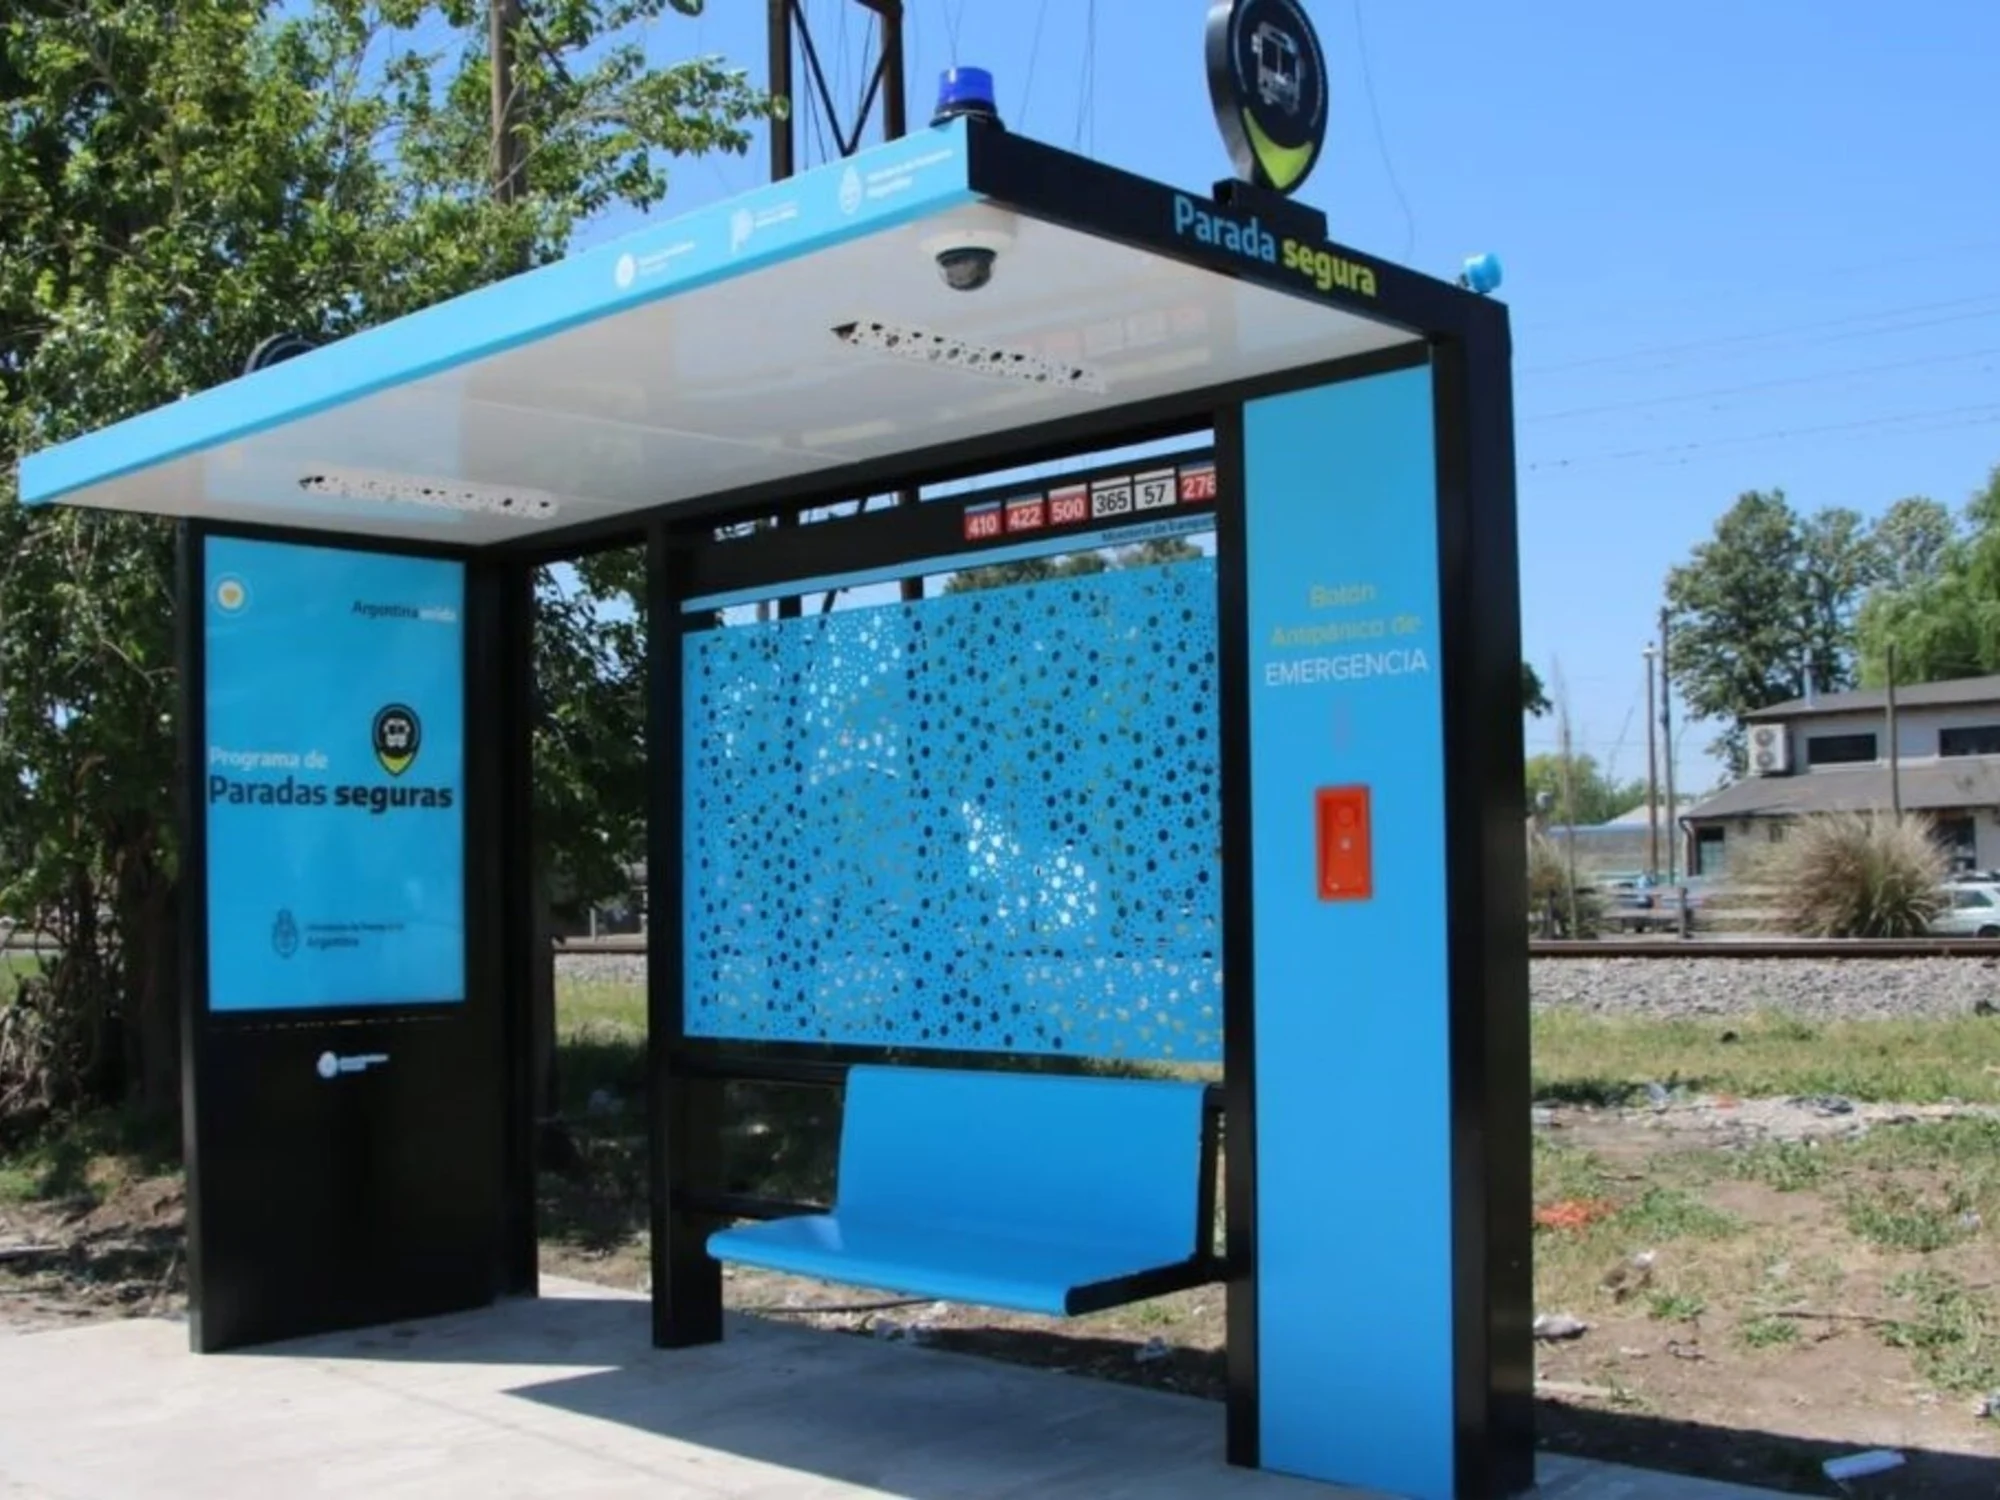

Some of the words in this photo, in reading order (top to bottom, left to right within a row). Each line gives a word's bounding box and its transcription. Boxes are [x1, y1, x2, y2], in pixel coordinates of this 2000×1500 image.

[1173, 194, 1276, 264] Parada
[1282, 238, 1376, 297] segura
[1095, 490, 1128, 514] 365
[1143, 483, 1167, 506] 57
[1010, 505, 1041, 527] 422
[1051, 498, 1085, 522] 500
[967, 513, 998, 535] 410
[352, 600, 418, 619] Argentina
[1264, 648, 1428, 687] EMERGENCIA
[209, 747, 299, 771] Programa
[304, 750, 329, 769] de
[209, 775, 328, 806] Paradas
[334, 785, 454, 814] seguras
